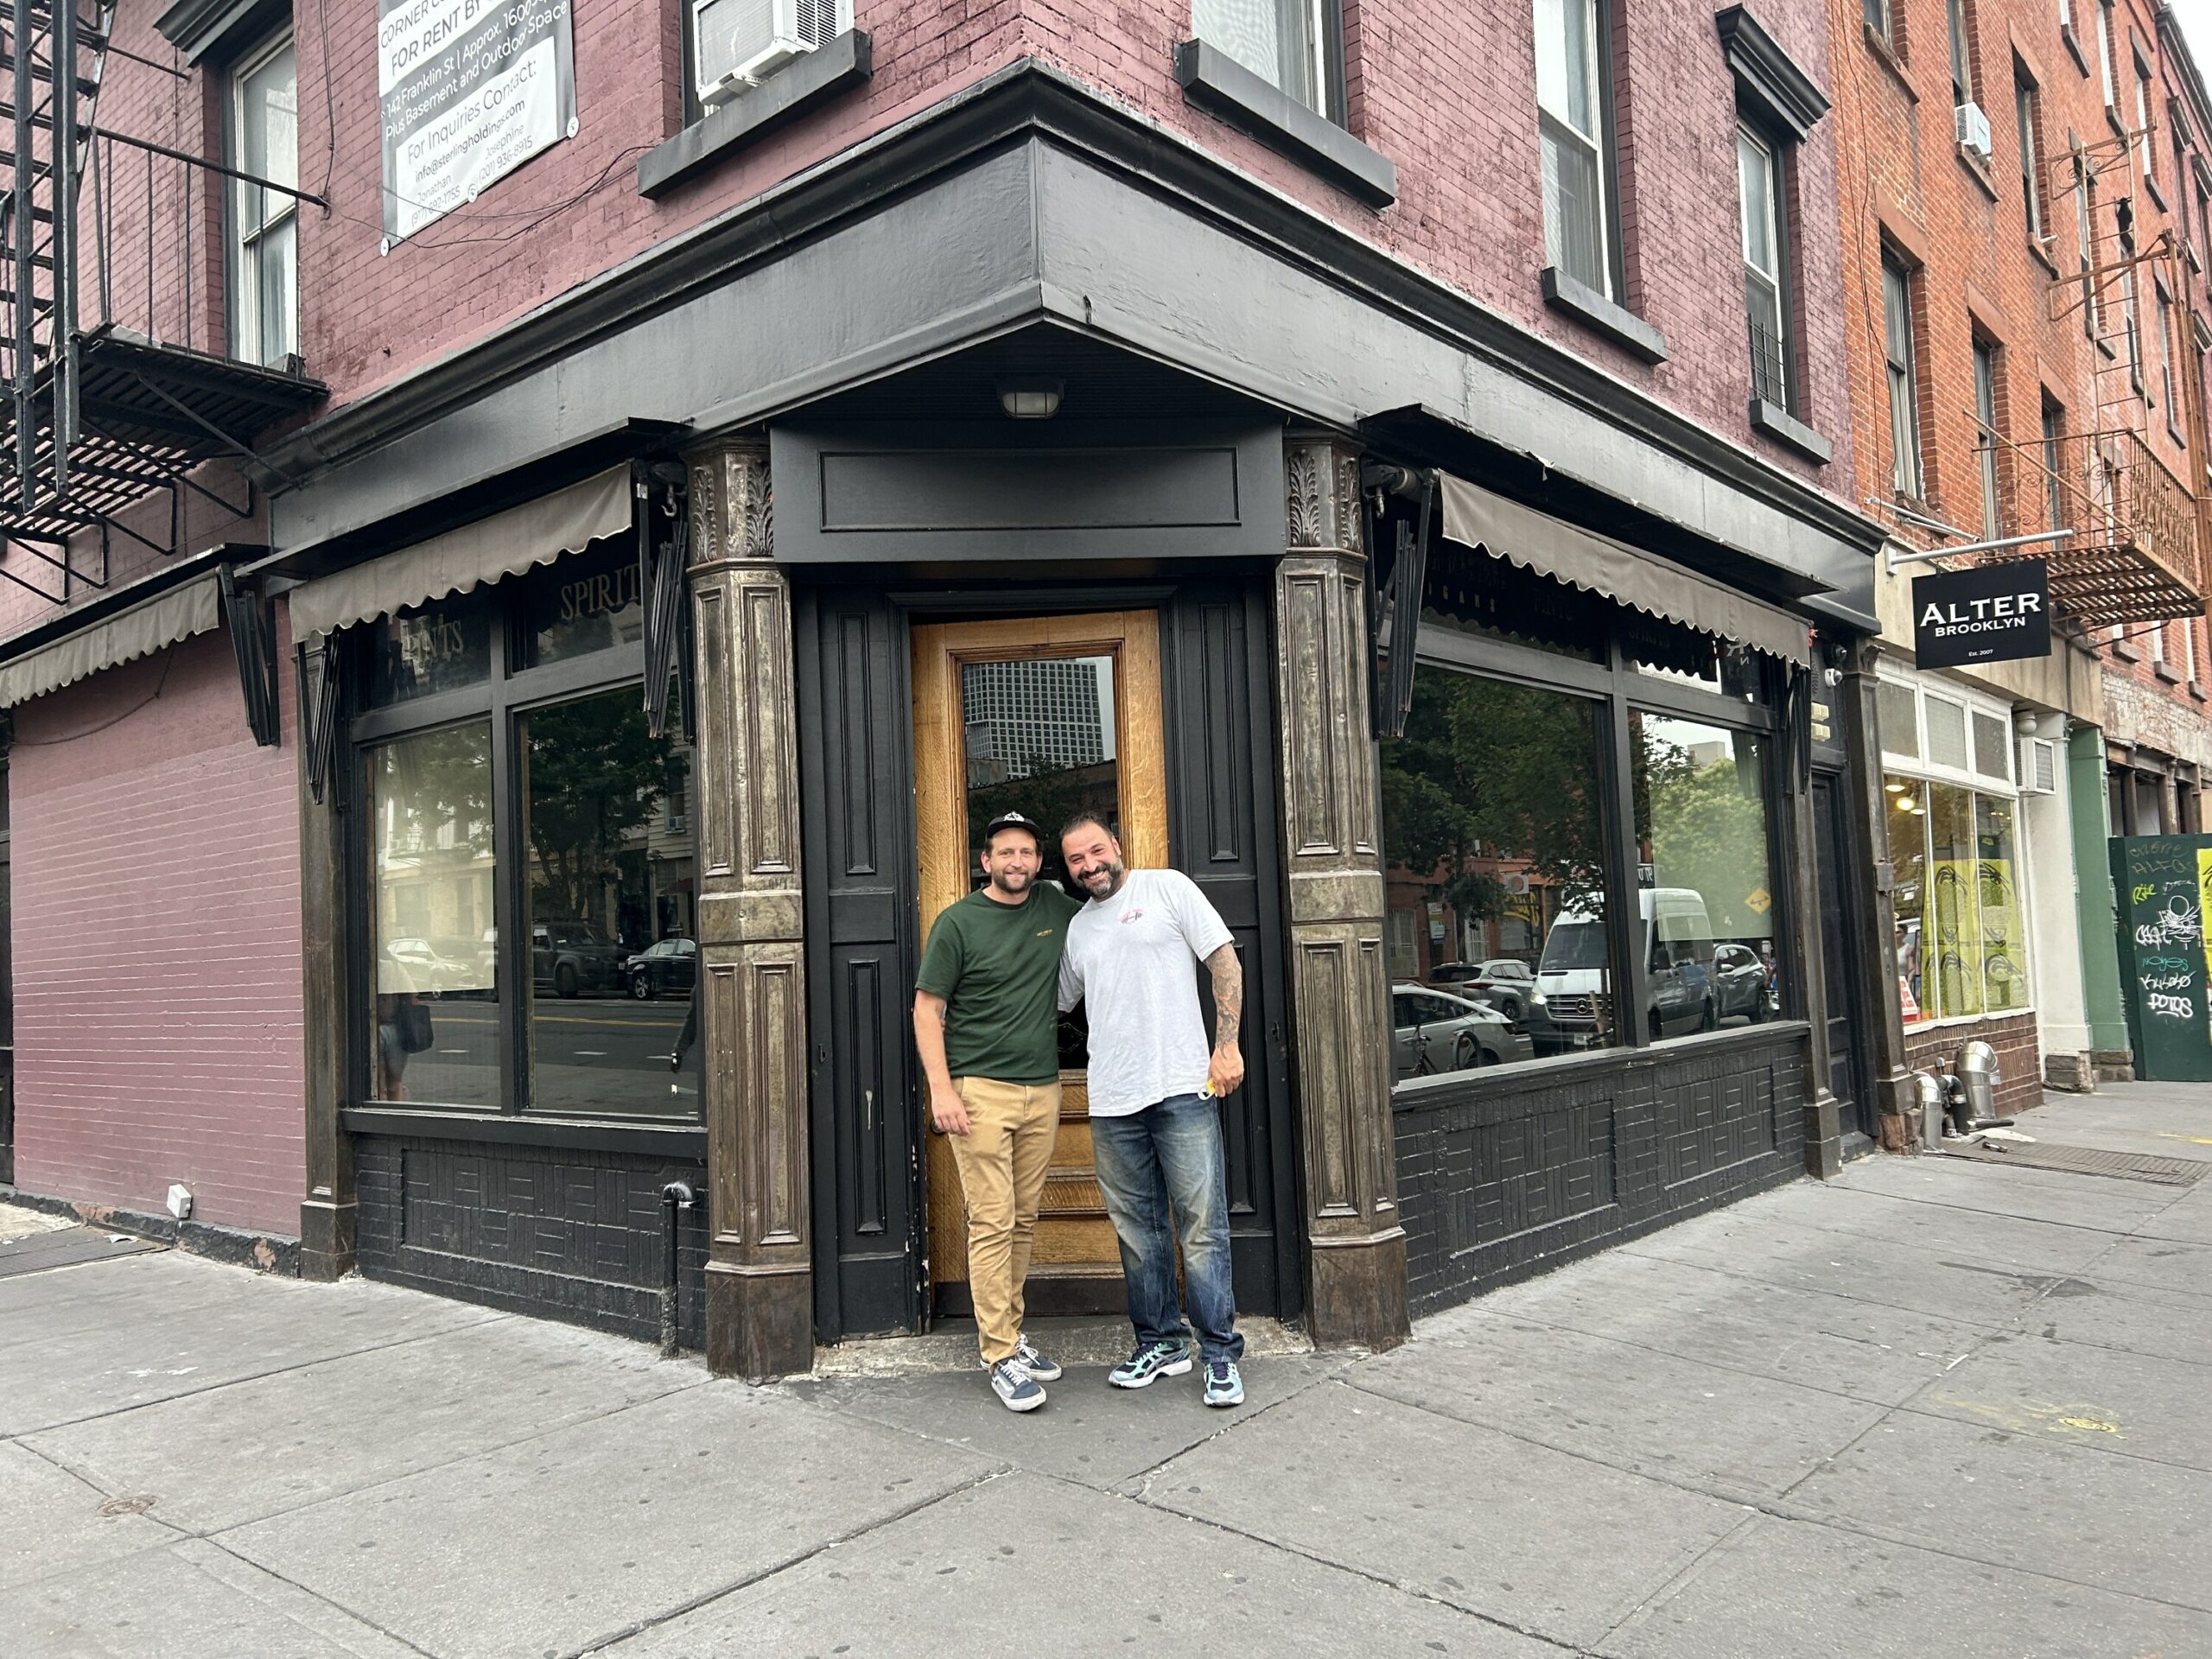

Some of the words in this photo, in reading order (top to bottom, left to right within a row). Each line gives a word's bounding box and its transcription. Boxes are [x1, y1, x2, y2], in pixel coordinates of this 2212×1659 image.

[381, 0, 429, 48] CORNER
[391, 41, 419, 76] FOR
[423, 6, 461, 52] RENT
[385, 118, 405, 142] Plus
[405, 79, 458, 125] Basement
[460, 59, 480, 88] and
[481, 27, 528, 70] Outdoor
[527, 1, 568, 34] Space
[386, 96, 401, 118] 142
[401, 67, 442, 105] Franklin
[443, 55, 455, 75] St
[462, 22, 502, 62] Approx.
[503, 0, 531, 29] 1600
[407, 140, 425, 165] For
[428, 102, 480, 150] Inquiries
[482, 60, 537, 111] Contact:
[485, 124, 524, 160] Josephine
[416, 173, 452, 206] Jonathan
[478, 159, 495, 184] (201)
[1920, 592, 2042, 627] ALTER
[1935, 616, 2026, 638] BROOKLYN
